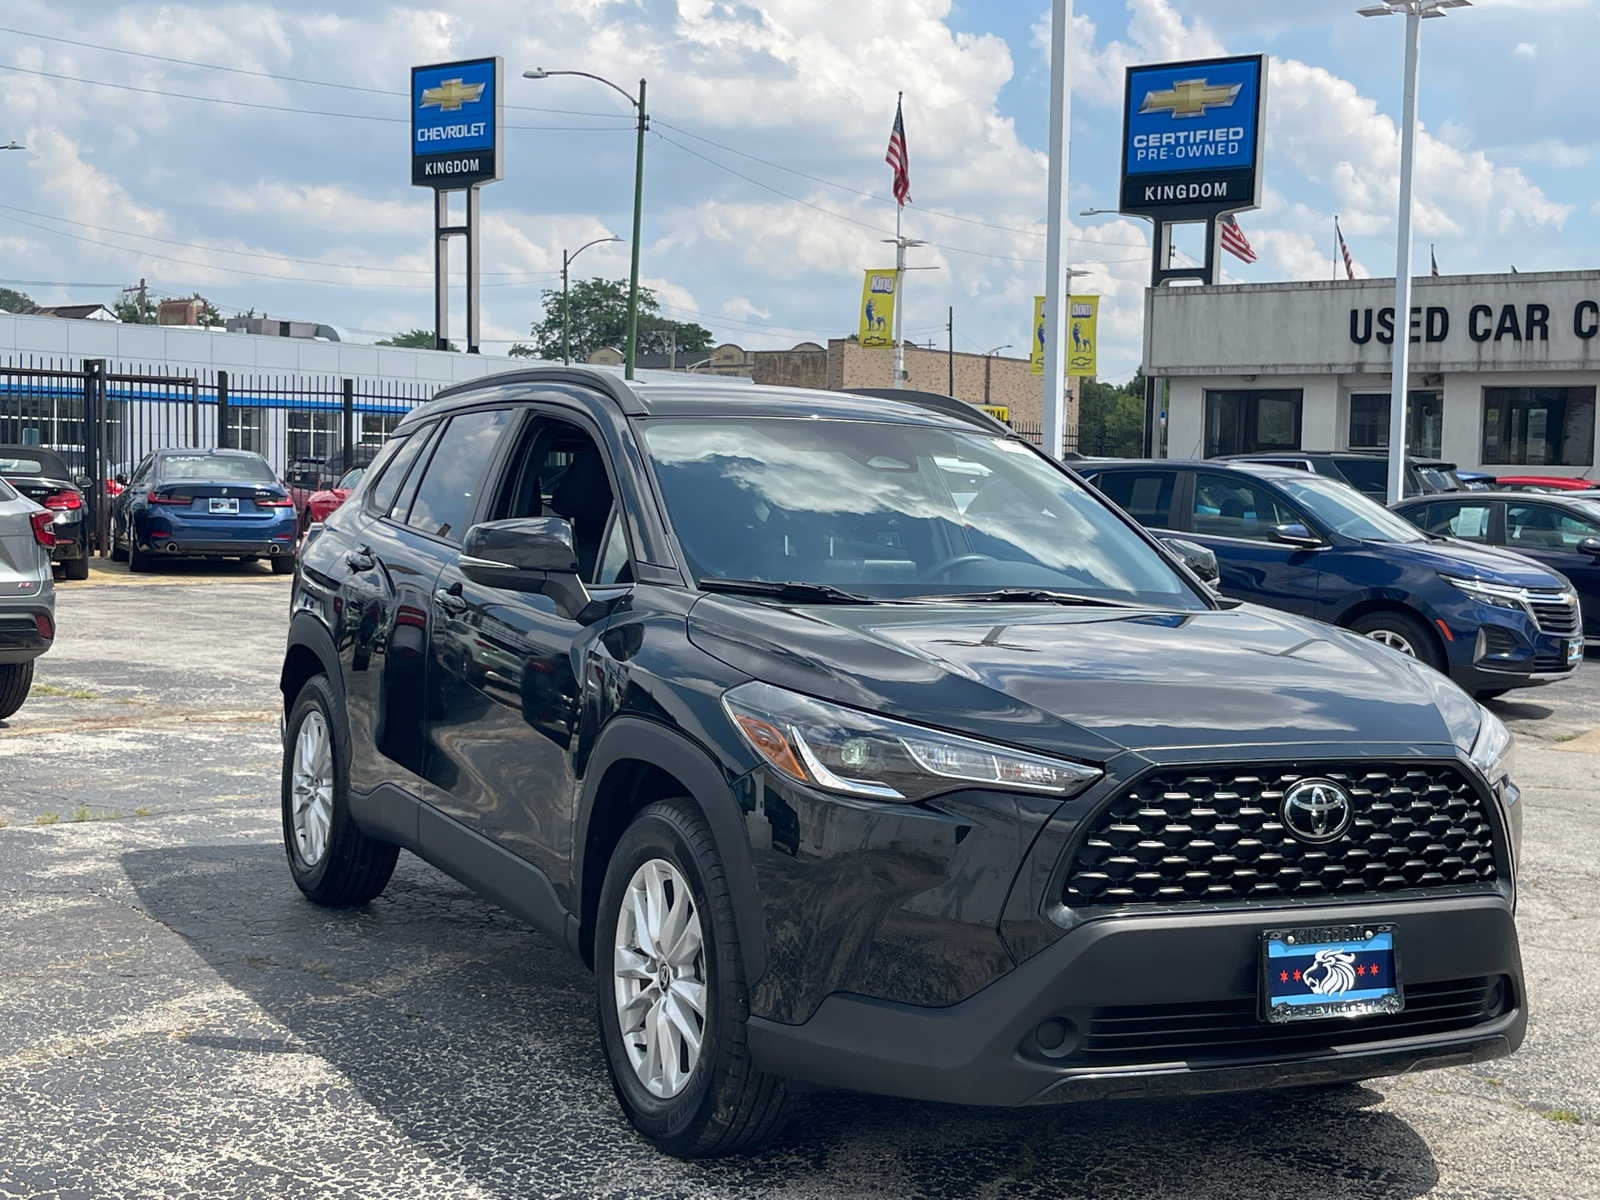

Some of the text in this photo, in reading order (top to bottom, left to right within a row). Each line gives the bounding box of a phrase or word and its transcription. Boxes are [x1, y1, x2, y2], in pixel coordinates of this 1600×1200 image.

[417, 122, 487, 142] CHEVROLET
[1133, 127, 1244, 148] CERTIFIED
[1137, 142, 1239, 161] PRE-OWNED
[425, 158, 480, 175] KINGDOM
[1144, 182, 1228, 201] KINGDOM
[870, 275, 894, 294] King
[1072, 302, 1093, 318] dom
[1350, 306, 1449, 344] USED
[1469, 303, 1550, 343] CAR
[1295, 926, 1364, 944] KINGDOM
